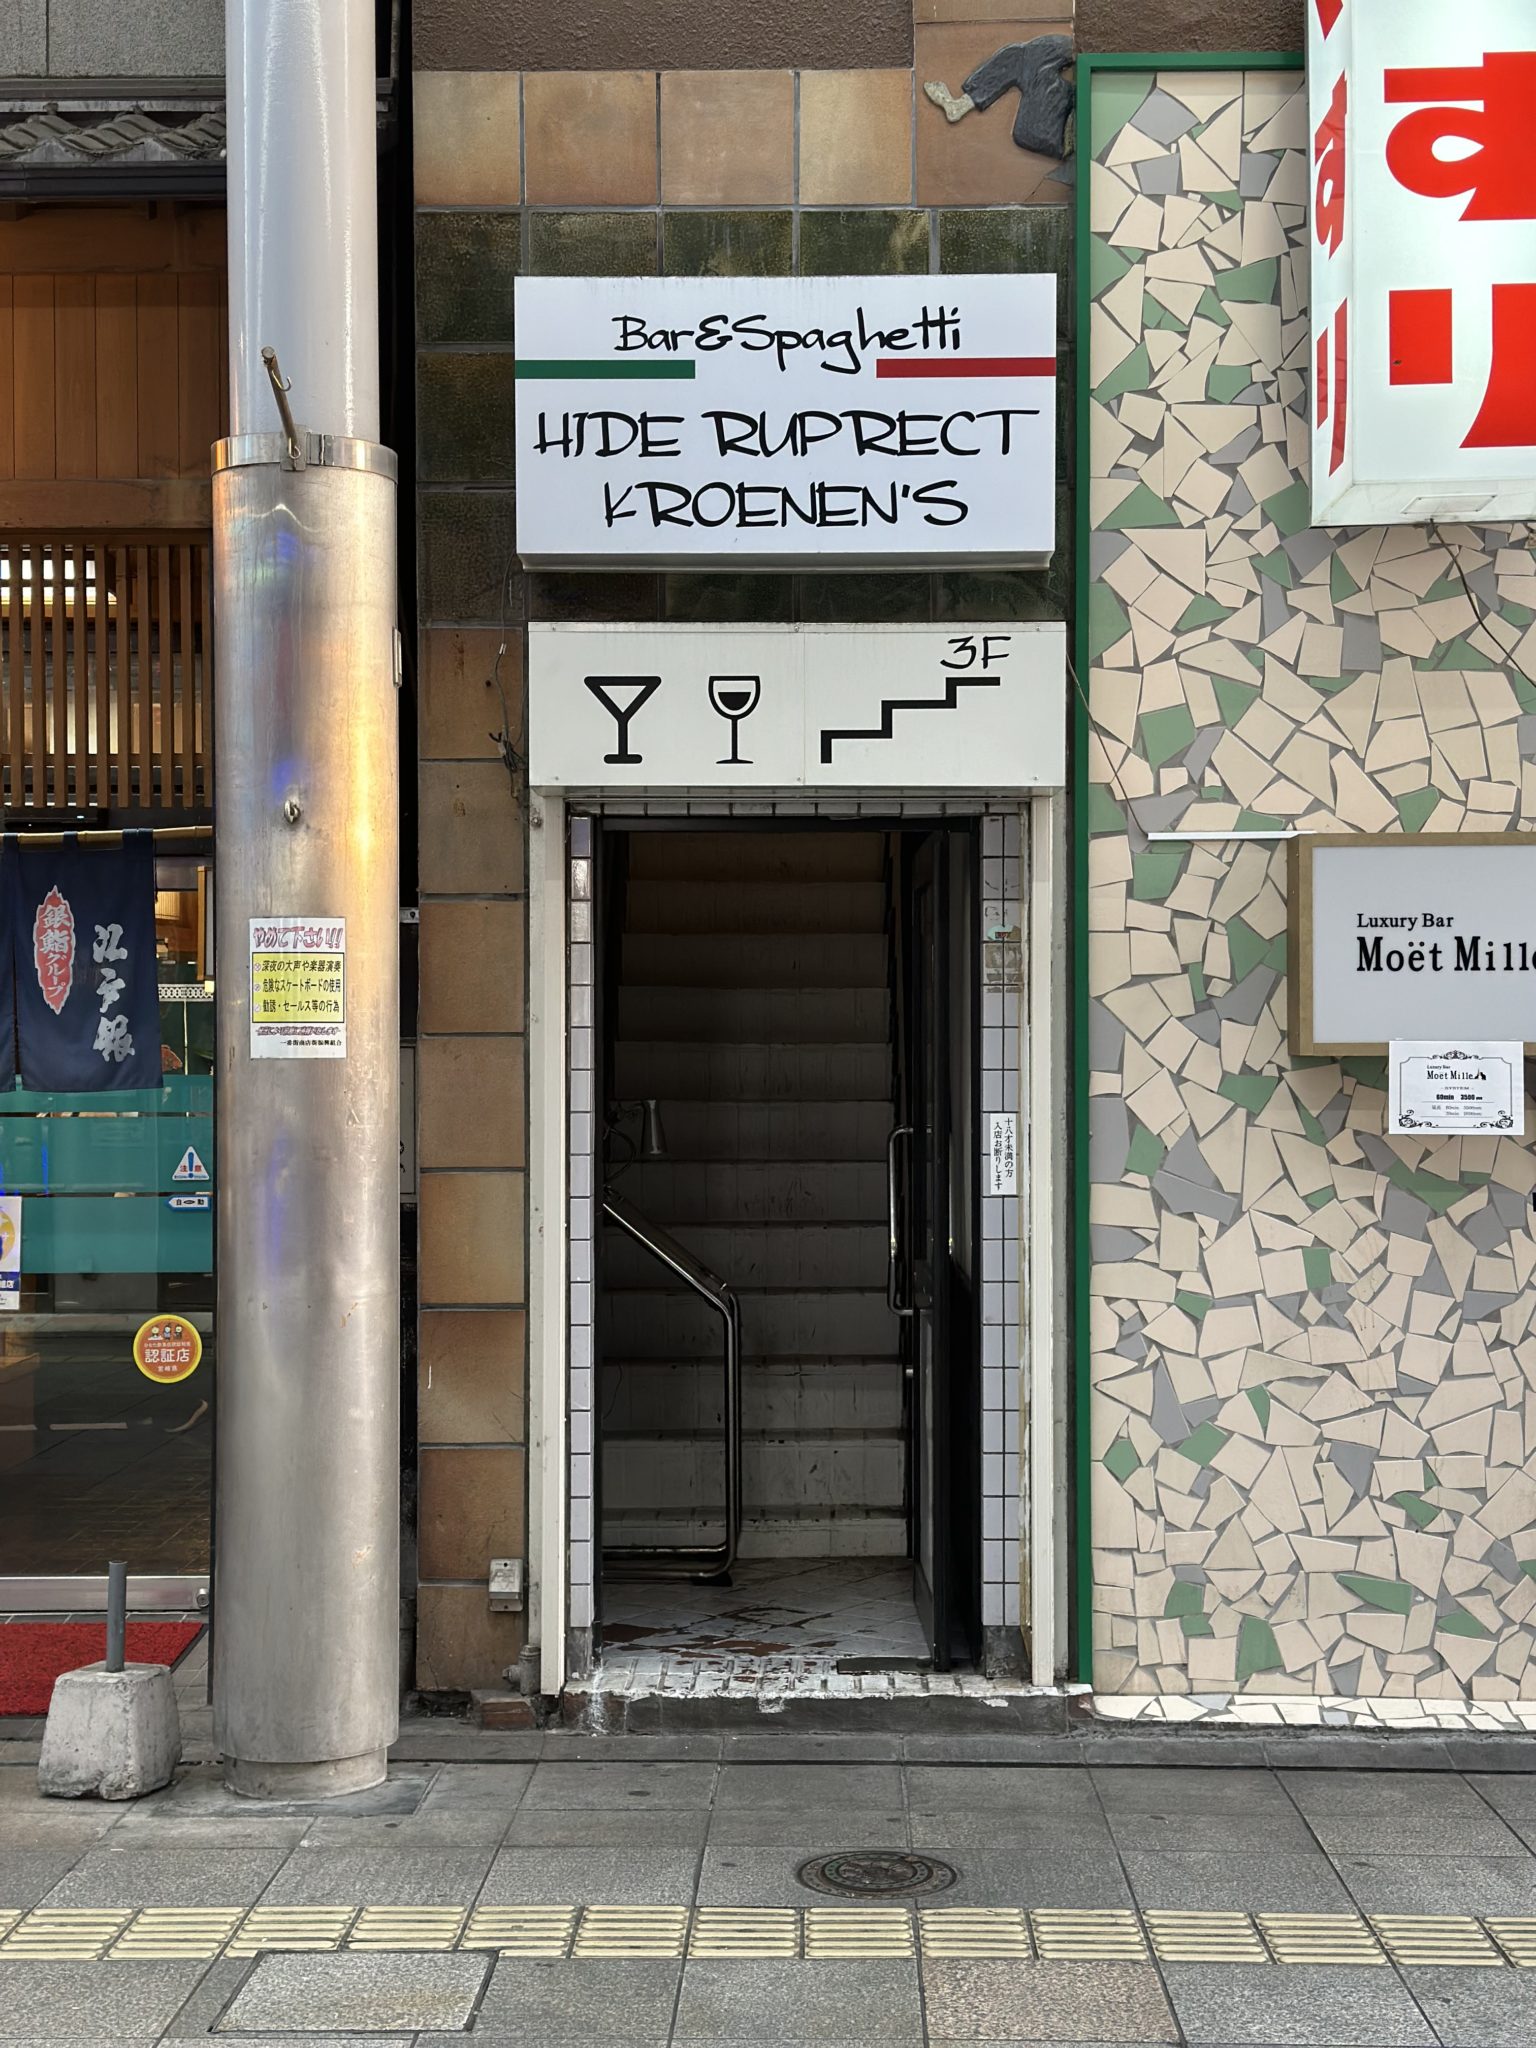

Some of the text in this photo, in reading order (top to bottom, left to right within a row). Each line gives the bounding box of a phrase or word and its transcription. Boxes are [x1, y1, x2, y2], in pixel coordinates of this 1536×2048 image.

[1315, 0, 1348, 478] すり
[611, 306, 961, 374] Bar&Spaghetti
[533, 410, 1040, 458] HIDE RUPRECT
[604, 480, 969, 528] KROENEN'S
[940, 636, 1012, 669] 3F
[1356, 913, 1454, 931] Luxury Bar
[39, 904, 71, 999] 銀鮨グループ
[261, 960, 341, 972] 深夜の大声や楽器演奏
[1356, 936, 1536, 972] Moët Mill
[93, 923, 135, 1063] 江戸銀
[262, 978, 341, 992] 危険なスケートボードの使用
[993, 1122, 1003, 1191] 入店お断りします
[1004, 1117, 1013, 1178] 十八才未満の方
[144, 1348, 190, 1363] 認証店
